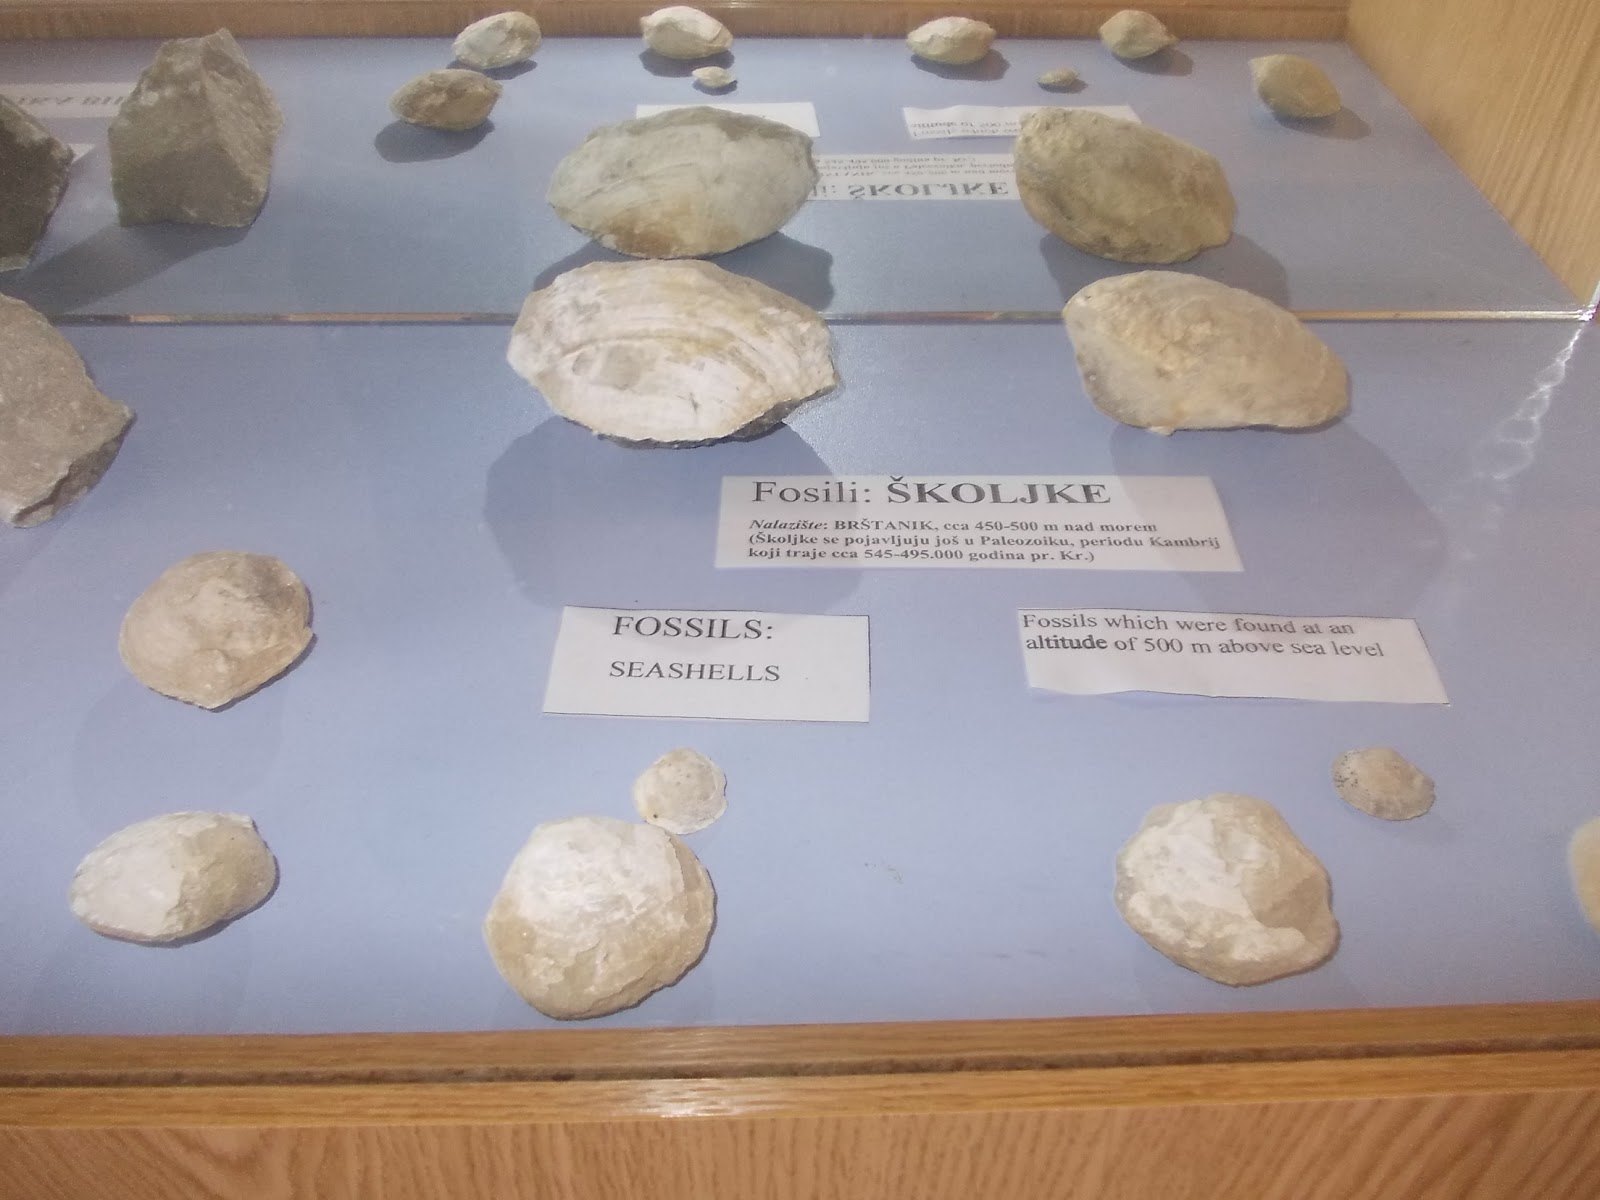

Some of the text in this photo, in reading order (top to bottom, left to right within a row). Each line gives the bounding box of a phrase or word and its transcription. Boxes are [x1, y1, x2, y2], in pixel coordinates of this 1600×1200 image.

[752, 476, 1111, 504] Fosili: ŠKOLJKE
[749, 518, 1157, 532] Nalazište: BRŠTANIK, cca 450-500 m nad morem
[749, 531, 818, 547] (Školjke
[823, 536, 839, 544] se
[844, 533, 929, 547] pojavljuju
[935, 534, 959, 547] još
[981, 536, 1075, 548] Paleozoiku,
[1080, 537, 1143, 549] periodu
[1149, 536, 1221, 549] Kambrij
[749, 548, 1095, 562] koji traje cca 545-495.000 godina pr. Kr.)
[612, 616, 773, 640] FOSSILS:
[1023, 614, 1354, 634] Fossils which were found at an
[1026, 635, 1384, 657] altitude of 500 m above sea level
[609, 661, 780, 681] SEASHELLS
